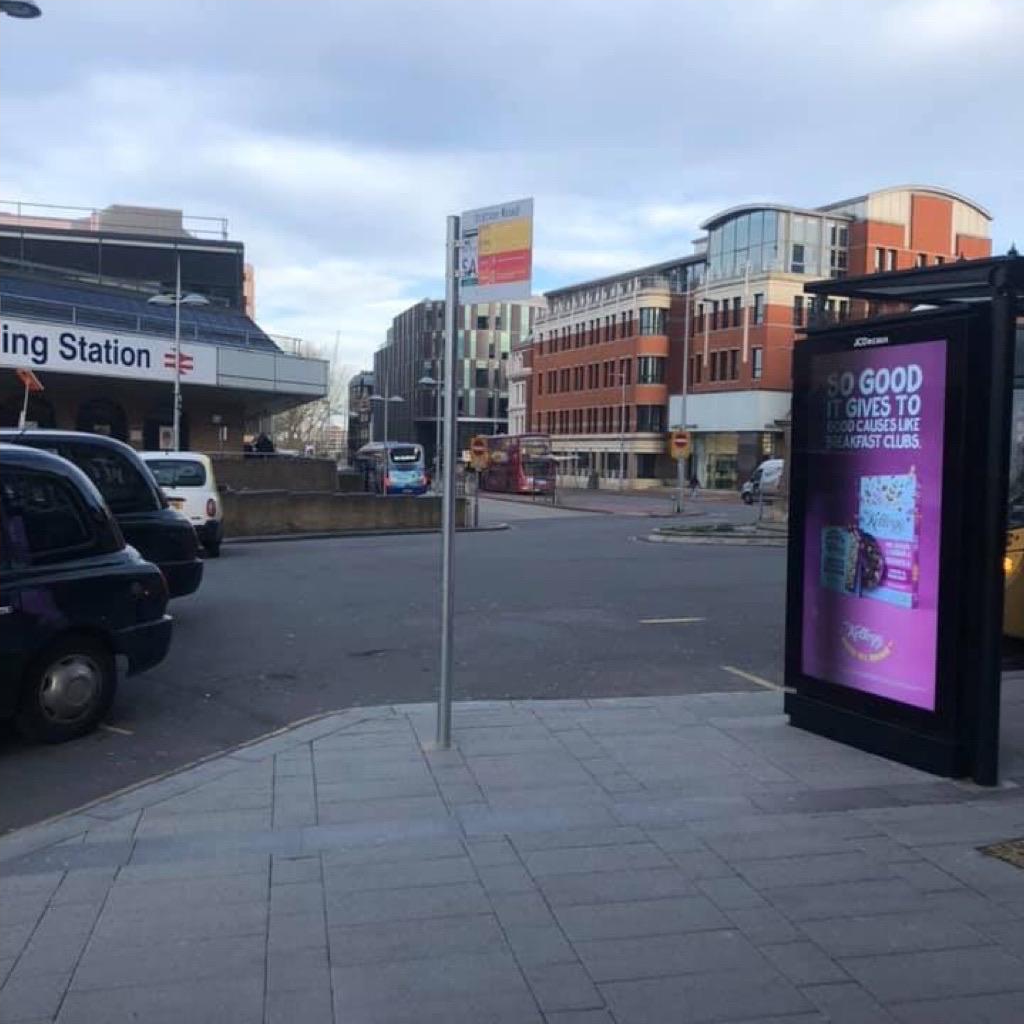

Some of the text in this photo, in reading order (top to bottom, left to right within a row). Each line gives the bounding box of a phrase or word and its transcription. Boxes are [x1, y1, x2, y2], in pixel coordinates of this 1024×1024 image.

[59, 332, 151, 369] Station
[827, 363, 923, 396] SO GOOD
[846, 396, 892, 418] GIVES
[895, 394, 921, 416] TO
[856, 417, 896, 432] CAUSES
[898, 416, 921, 432] LIKE
